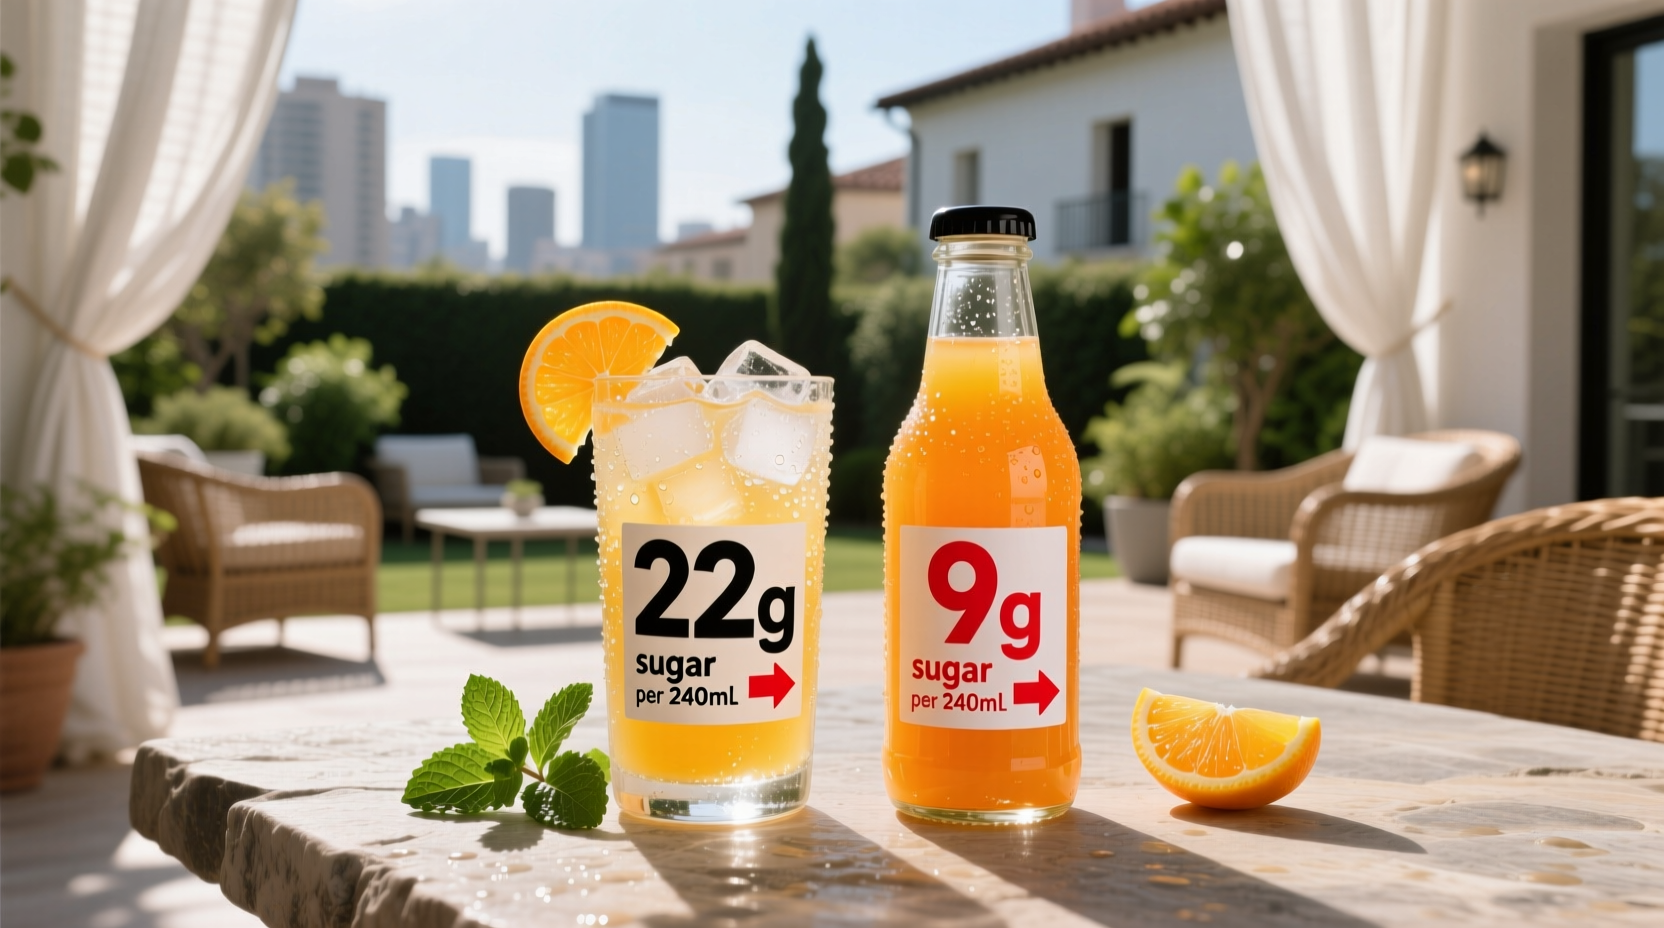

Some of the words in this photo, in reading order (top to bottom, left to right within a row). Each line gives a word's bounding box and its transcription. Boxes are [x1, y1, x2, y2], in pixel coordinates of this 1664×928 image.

[634, 539, 796, 654] 22g
[928, 540, 1041, 660] 9g
[636, 653, 717, 684] sugar
[912, 658, 993, 690] sugar
[636, 688, 664, 708] per
[669, 685, 739, 706] 240mL
[911, 693, 938, 712] per
[942, 692, 1008, 712] 240mL
